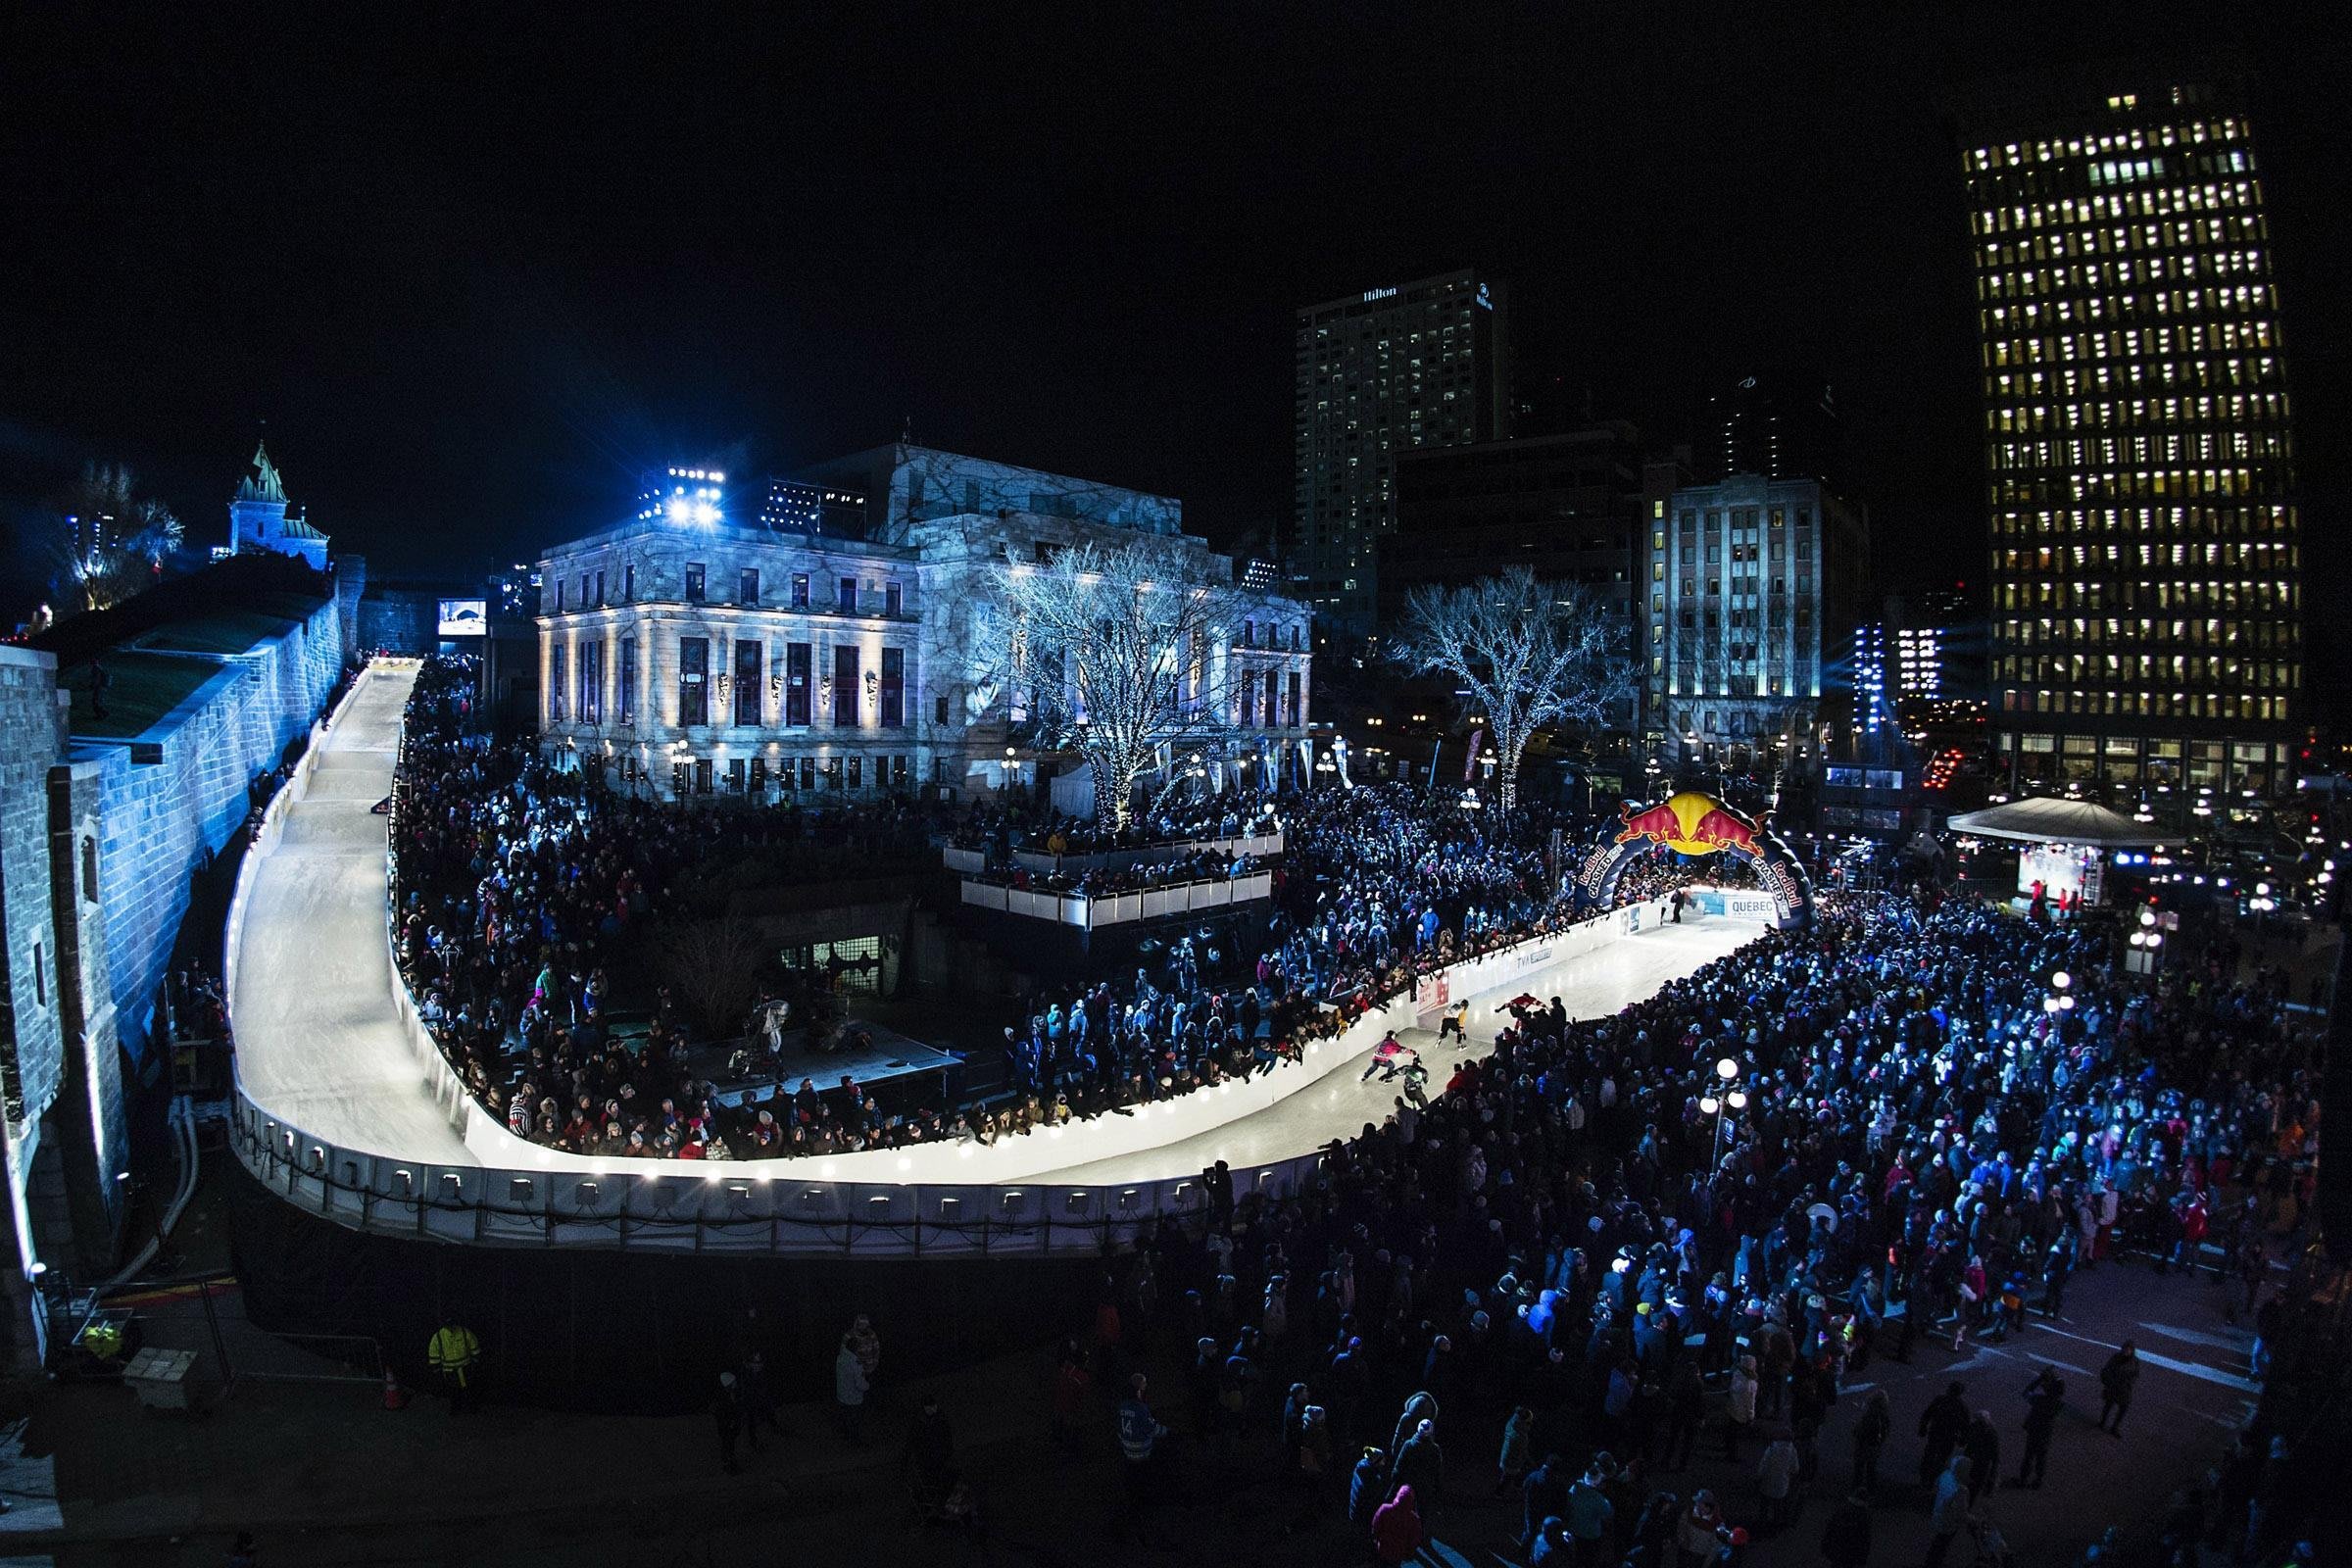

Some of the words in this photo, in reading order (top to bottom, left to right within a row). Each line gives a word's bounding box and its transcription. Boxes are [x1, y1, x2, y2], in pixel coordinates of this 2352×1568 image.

[1363, 288, 1396, 302] Hilton
[1588, 856, 1613, 899] CRASHED
[1606, 843, 1625, 860] ICE
[1751, 857, 1786, 902] CRASHED
